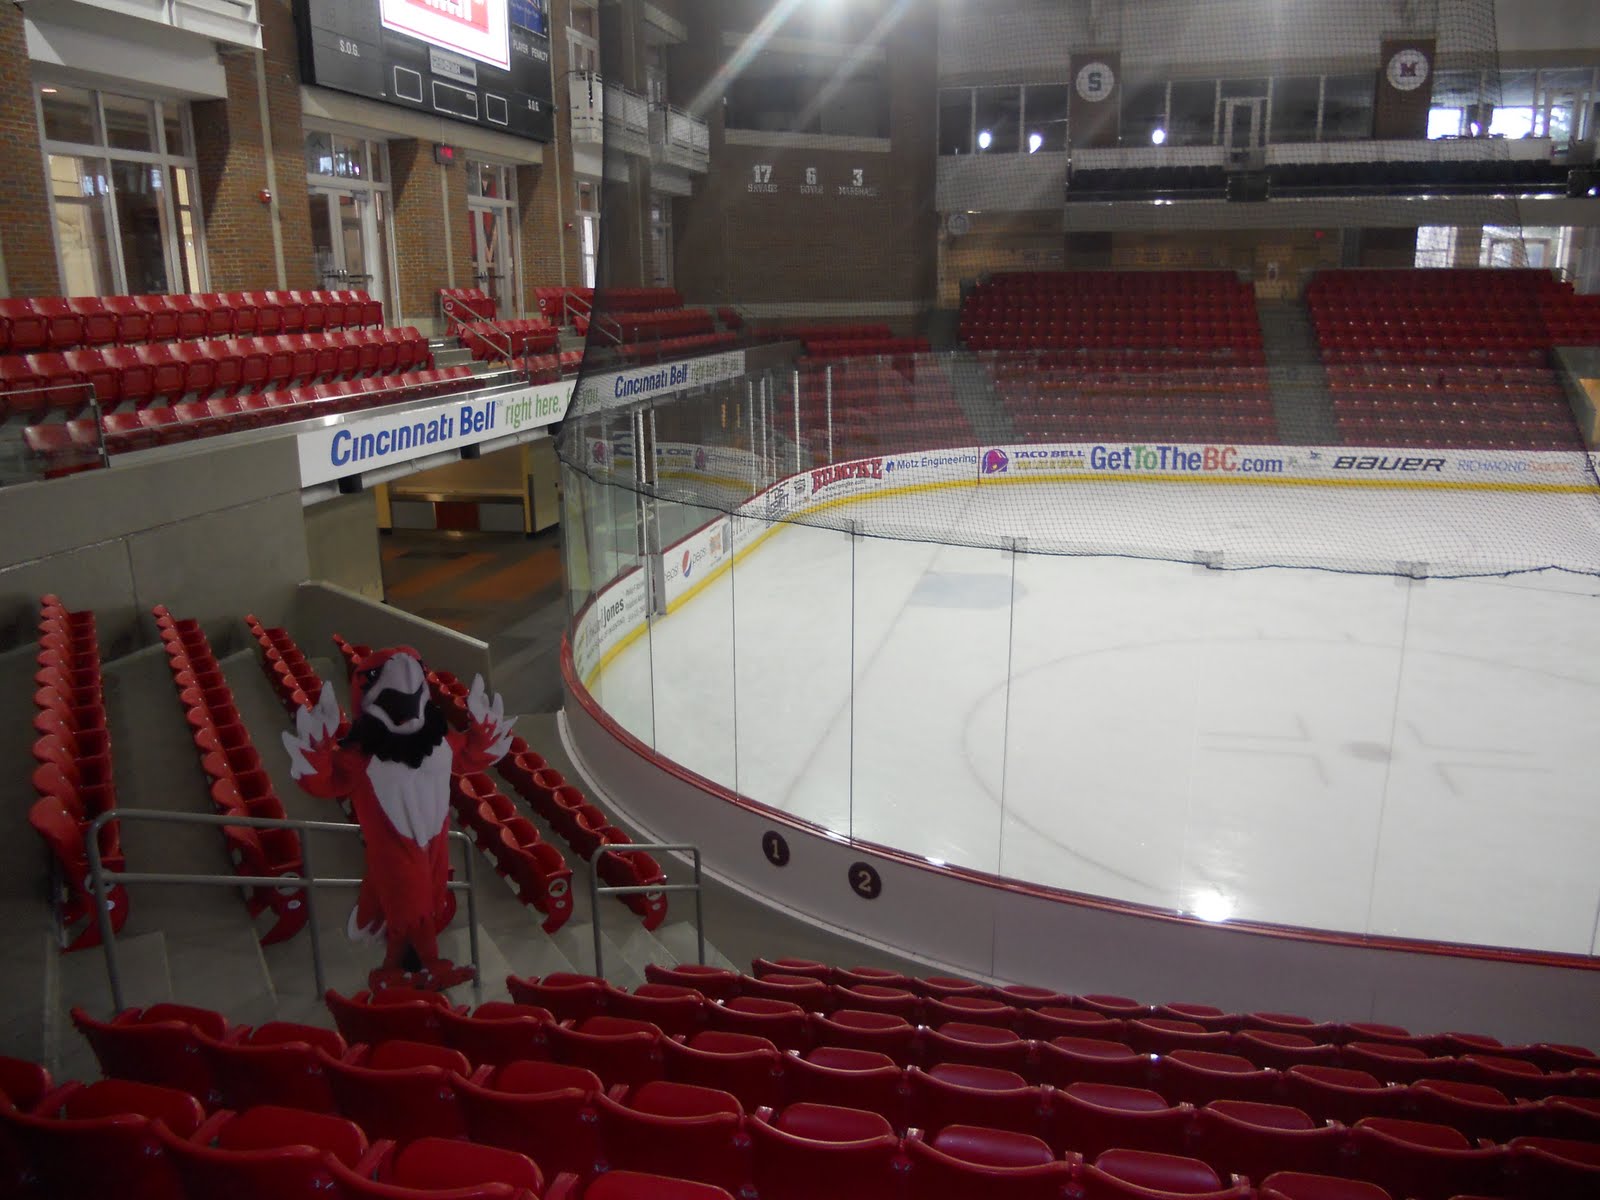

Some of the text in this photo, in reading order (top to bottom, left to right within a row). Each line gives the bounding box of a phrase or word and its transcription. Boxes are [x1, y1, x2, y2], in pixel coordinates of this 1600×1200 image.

[340, 40, 360, 57] S.O.G.
[1400, 62, 1418, 77] M
[1087, 72, 1102, 91] S
[753, 165, 772, 183] 17
[806, 167, 817, 185] 6
[853, 169, 863, 186] 3
[747, 184, 778, 193] SAVAGE
[615, 370, 668, 398] Cincinnati
[670, 363, 688, 386] Bell
[331, 415, 453, 467] Cincinnati
[460, 401, 496, 437] Bell
[505, 396, 532, 429] right
[535, 394, 562, 418] here.
[897, 453, 978, 470] Motz Engineering
[1014, 450, 1085, 459] TACO BELL
[1090, 445, 1284, 473] GetToTheBC.com
[1333, 456, 1446, 472] BAUER
[811, 458, 883, 495] RUMPKE
[603, 599, 625, 628] Jones
[771, 839, 780, 860] 1
[858, 870, 872, 892] 2
